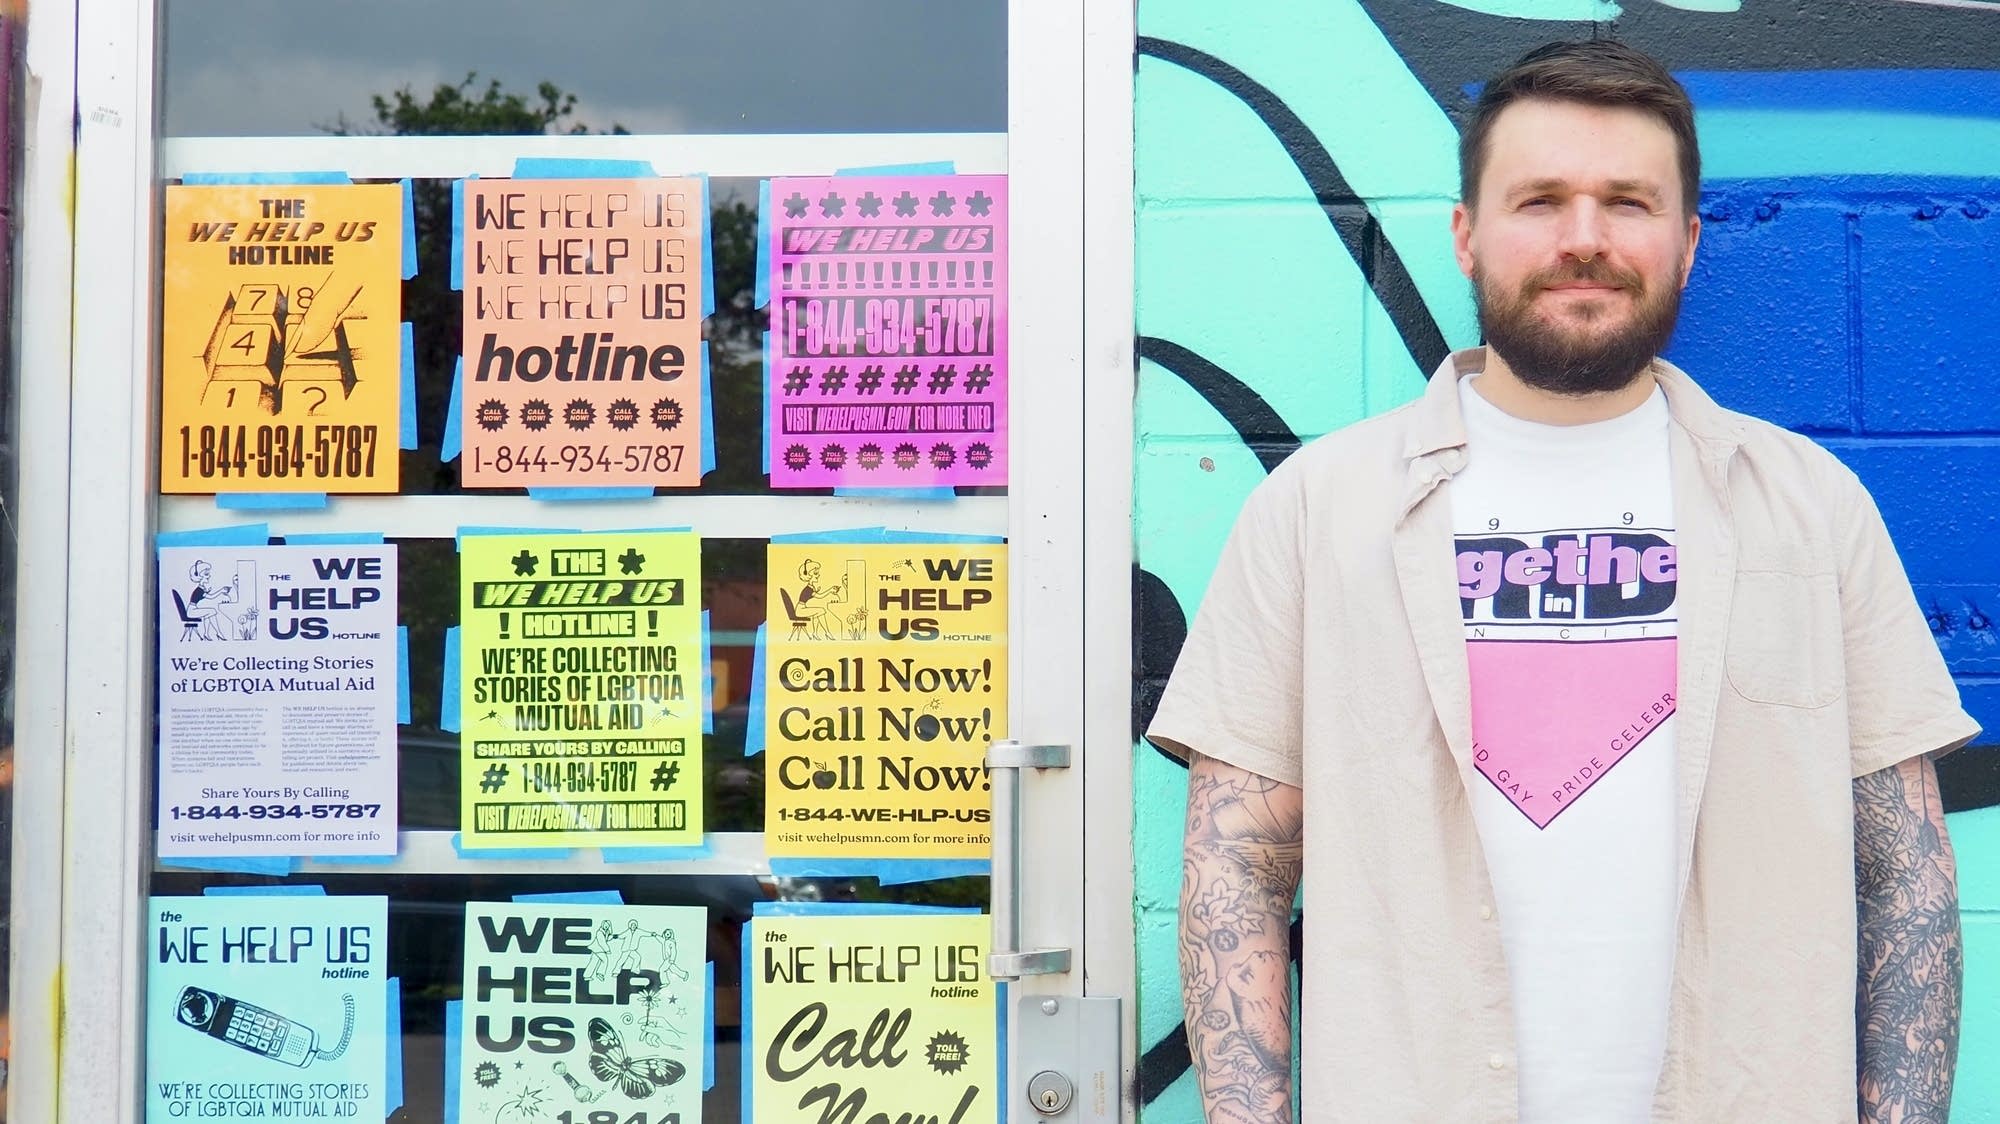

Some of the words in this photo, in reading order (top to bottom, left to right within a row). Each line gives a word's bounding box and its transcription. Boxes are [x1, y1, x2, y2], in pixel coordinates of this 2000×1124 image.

[259, 200, 305, 218] THE
[476, 194, 525, 230] WE
[540, 194, 627, 229] HELP
[643, 194, 685, 227] US
[189, 222, 238, 242] WE
[244, 222, 324, 242] HELP
[335, 222, 376, 242] US
[789, 230, 843, 252] WE
[848, 230, 933, 251] HELP
[943, 229, 990, 250] US
[229, 246, 333, 265] HOTLINE
[477, 240, 524, 274] WE
[539, 239, 628, 275] HELP
[643, 239, 685, 273] US
[249, 290, 267, 311] 7
[297, 287, 313, 309] 8
[477, 286, 524, 319] WE
[540, 285, 627, 319] HELP
[642, 284, 685, 319] US
[786, 298, 990, 354] 1-844-934-5787
[230, 331, 255, 356] 4
[475, 333, 684, 382] hotline
[226, 388, 236, 408] 1
[785, 408, 813, 431] VISIT
[816, 407, 912, 431] WEHELPUSMN.COM
[915, 407, 936, 429] FOR
[937, 406, 966, 429] MORE
[967, 406, 990, 429] INFO
[180, 425, 377, 478] 1-844-934-5787
[475, 446, 684, 473] 1-844-934-5787
[312, 558, 381, 580] WE
[554, 552, 603, 573] THE
[923, 559, 992, 581] WE
[1456, 536, 1677, 599] gethe
[269, 587, 380, 610] HELP
[482, 585, 535, 605] WE
[538, 584, 623, 604] HELP
[630, 582, 677, 603] US
[879, 589, 991, 611] HELP
[1544, 594, 1572, 612] in
[268, 617, 328, 640] US
[524, 614, 633, 635] HOTLINE
[878, 619, 939, 641] US
[171, 657, 218, 671] We're
[223, 656, 309, 673] Collecting
[313, 656, 374, 670] Stories
[481, 648, 547, 674] WE'RE
[552, 646, 677, 673] COLLECTING
[171, 679, 188, 692] of
[192, 678, 273, 694] LGBTQIA
[279, 678, 339, 691] Mutual
[344, 677, 375, 691] Aid
[779, 657, 865, 693] Call
[878, 658, 991, 692] Now!
[474, 677, 561, 703] STORIES
[567, 676, 591, 702] OF
[598, 675, 684, 703] LGBTQIA
[515, 705, 603, 731] MUTUAL
[608, 704, 643, 730] AID
[778, 706, 865, 742] Call
[477, 743, 531, 755] SHARE
[534, 743, 589, 755] YOURS
[592, 742, 613, 755] BY
[615, 742, 682, 754] CALLING
[1498, 770, 1533, 802] GAY
[1552, 757, 1603, 802] PRIDE
[1611, 693, 1676, 751] CELEBR
[522, 761, 637, 793] 1-844-934-5787
[778, 755, 864, 791] Cll
[877, 756, 991, 791] Now!
[202, 788, 239, 798] Share
[242, 788, 279, 798] Yours
[283, 787, 300, 800] By
[303, 787, 349, 799] Calling
[171, 804, 381, 820] 1-844-934-5787
[478, 806, 505, 830] VISIT
[507, 805, 605, 830] WEHELPUSMN.COM
[607, 804, 627, 829] FOR
[628, 804, 657, 829] MORE
[658, 803, 683, 828] INFO
[778, 808, 991, 822] 1-844-WE-HLP-US
[170, 832, 195, 843] visit
[198, 831, 301, 844] wehelpusmn.com
[304, 831, 320, 842] for
[323, 834, 353, 842] more
[356, 831, 380, 841] info
[778, 833, 803, 843] visit
[806, 832, 910, 844] wehelpusmn.com
[913, 833, 930, 843] for
[933, 835, 964, 844] more
[967, 833, 990, 843] info
[161, 911, 182, 922] the
[160, 927, 208, 963] WE
[222, 927, 312, 963] HELP
[327, 927, 370, 963] US
[478, 916, 592, 954] WE
[765, 931, 787, 942] the
[322, 967, 369, 979] hotline
[765, 947, 815, 983] WE
[829, 946, 920, 983] HELP
[935, 946, 979, 982] US
[477, 966, 662, 1005] HELP
[930, 987, 978, 998] hotline
[476, 1016, 576, 1053] US
[766, 1002, 912, 1082] Call
[934, 1053, 961, 1061] FREE!
[936, 1044, 958, 1052] TOLL
[159, 1081, 202, 1099] WE'RE
[209, 1084, 303, 1099] COLLECTING
[309, 1084, 369, 1099] STORIES
[169, 1102, 190, 1117] OF
[199, 1102, 264, 1117] LGBTQIA
[272, 1102, 327, 1117] MUTUAL
[334, 1102, 357, 1116] AID
[798, 1083, 979, 1124] N!
